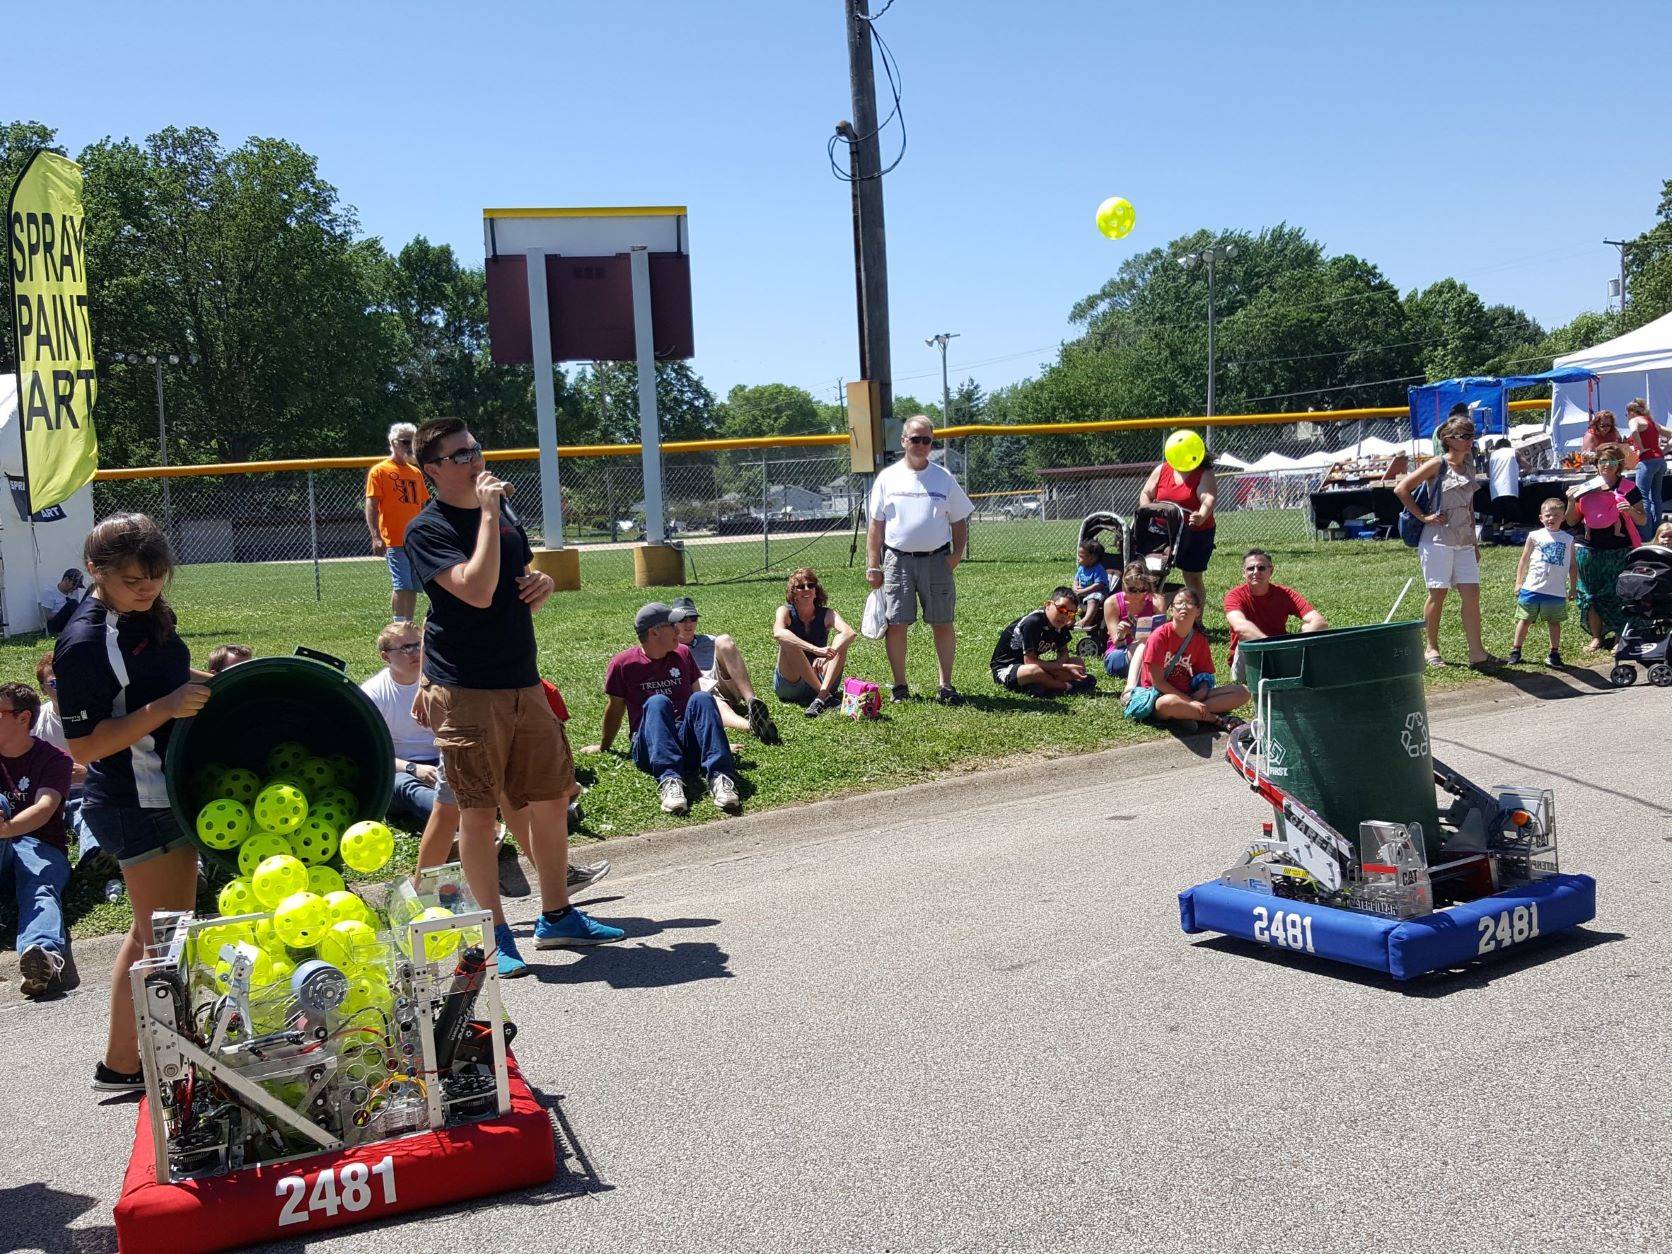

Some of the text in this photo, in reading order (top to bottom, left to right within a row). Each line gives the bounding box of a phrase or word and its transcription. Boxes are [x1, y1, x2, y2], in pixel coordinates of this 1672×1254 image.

[12, 211, 86, 283] SPRAY
[17, 294, 91, 361] PAINT
[26, 369, 95, 431] ART
[41, 506, 60, 518] ART
[640, 678, 682, 690] TREMONT
[1402, 869, 1418, 886] CAT
[1252, 906, 1315, 953] 2481
[1478, 901, 1540, 955] 2481
[275, 1155, 397, 1227] 2481
